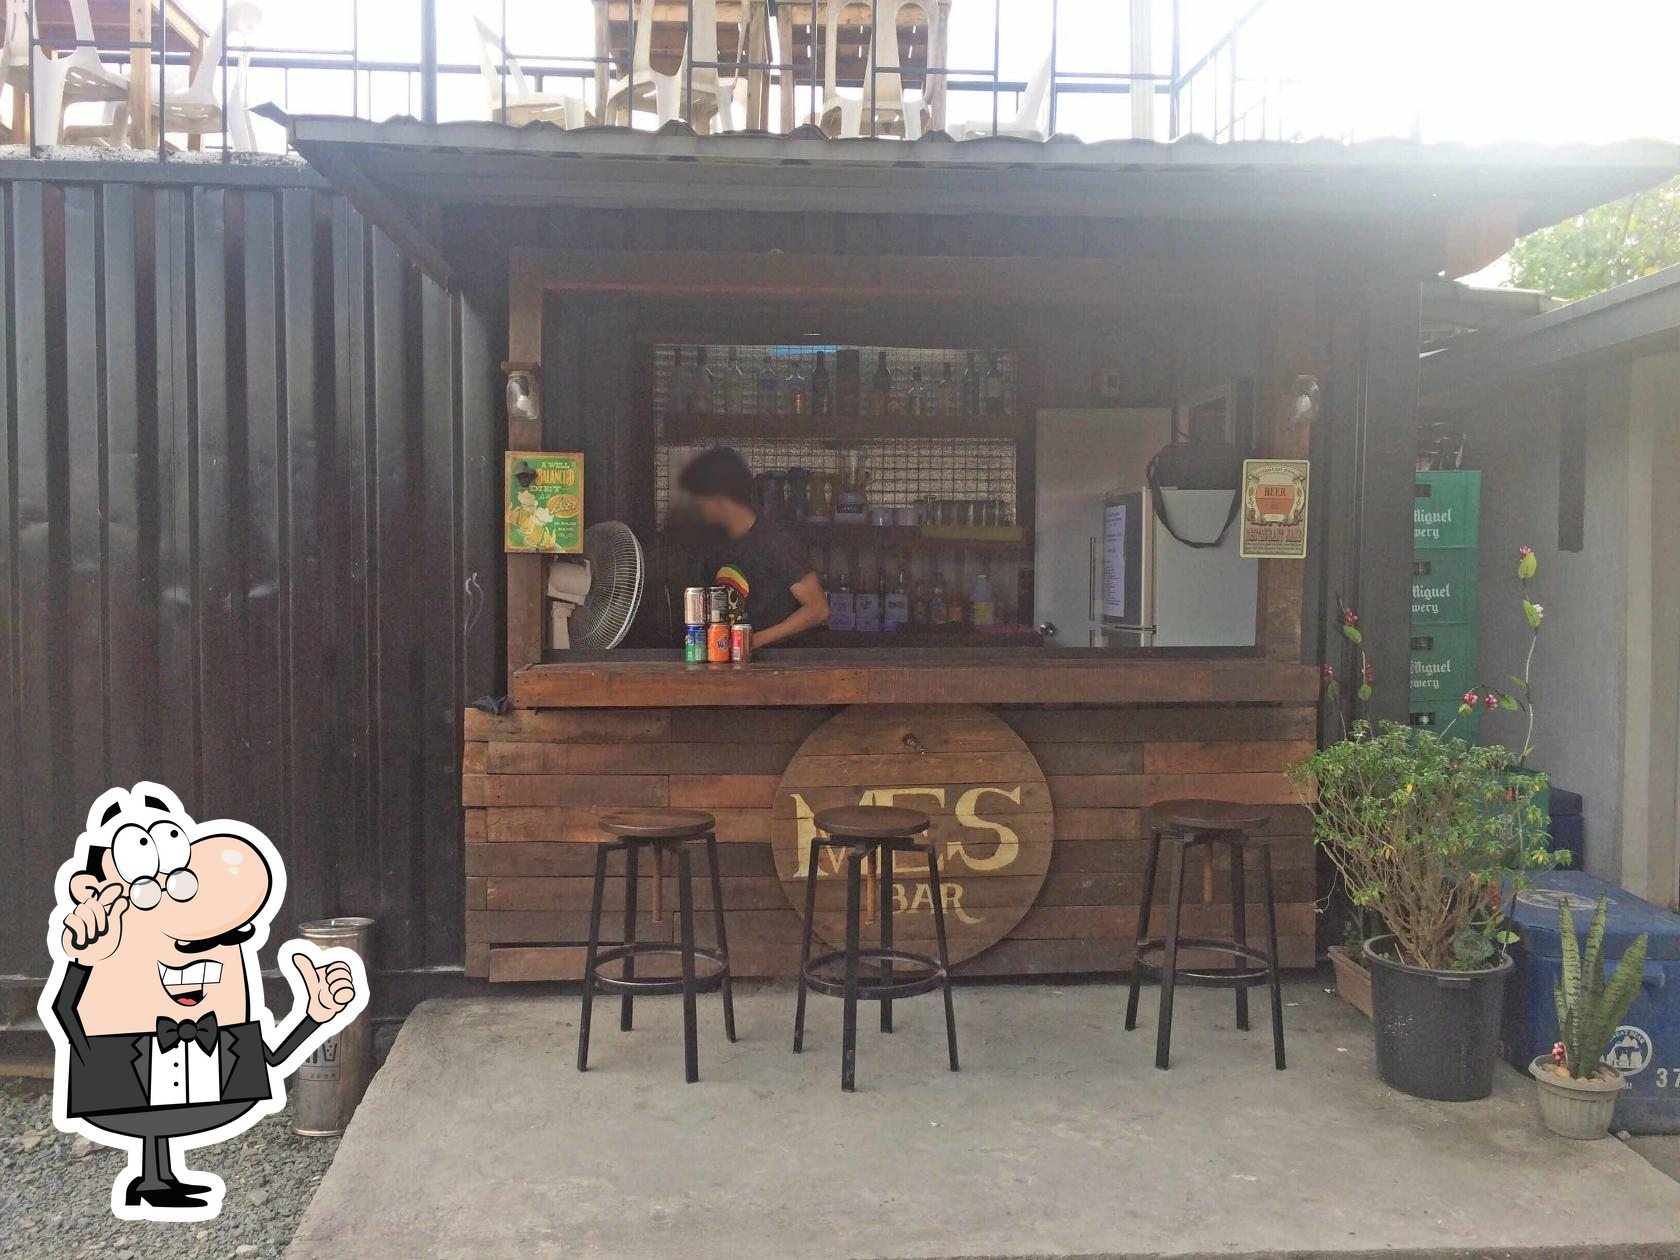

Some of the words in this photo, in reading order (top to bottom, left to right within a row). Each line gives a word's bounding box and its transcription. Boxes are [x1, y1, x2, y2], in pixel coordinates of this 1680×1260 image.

[1264, 487, 1286, 497] BEER
[790, 786, 1021, 878] MES
[891, 883, 985, 924] BAR
